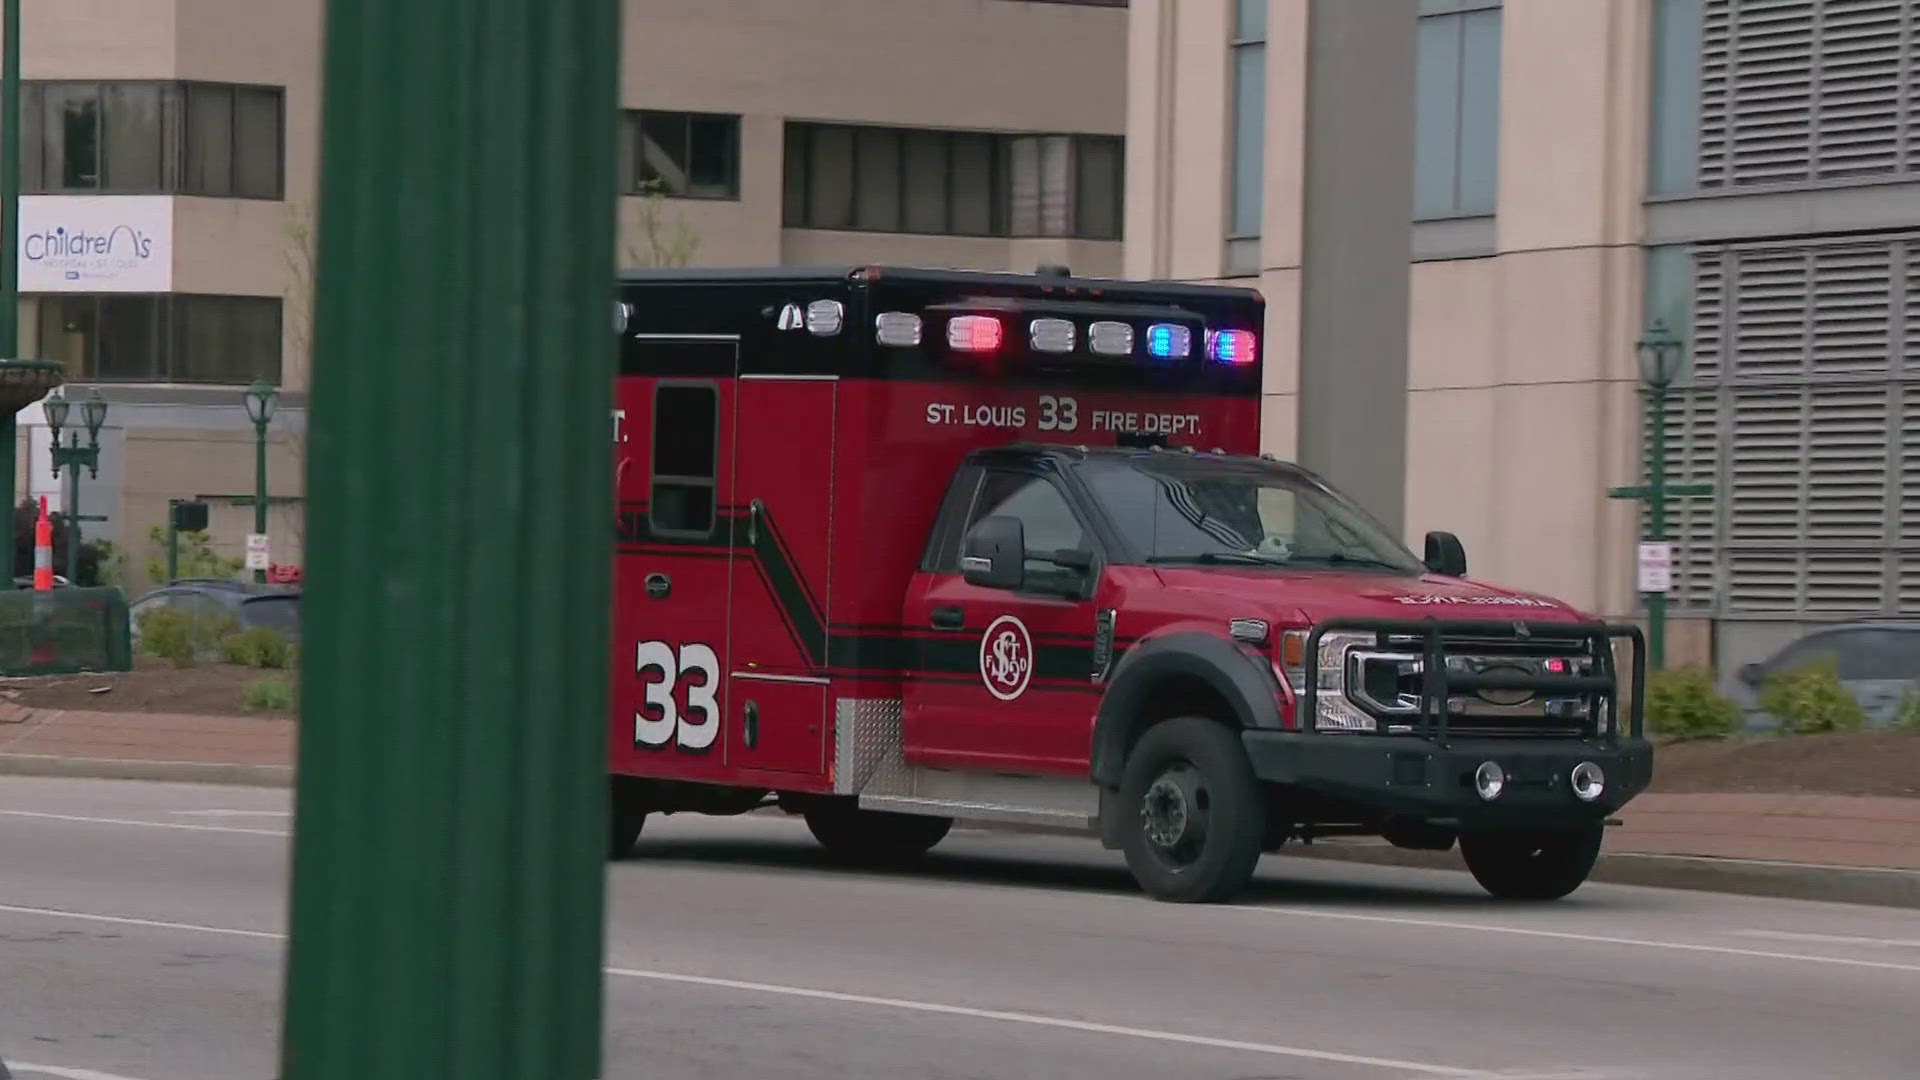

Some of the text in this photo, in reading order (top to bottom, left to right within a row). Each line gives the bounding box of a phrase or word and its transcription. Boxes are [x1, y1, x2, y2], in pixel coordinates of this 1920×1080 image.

[25, 225, 152, 260] Children's
[926, 395, 1202, 435] ST. LOUIS 33 FIRE DEPT.
[634, 640, 721, 750] 33
